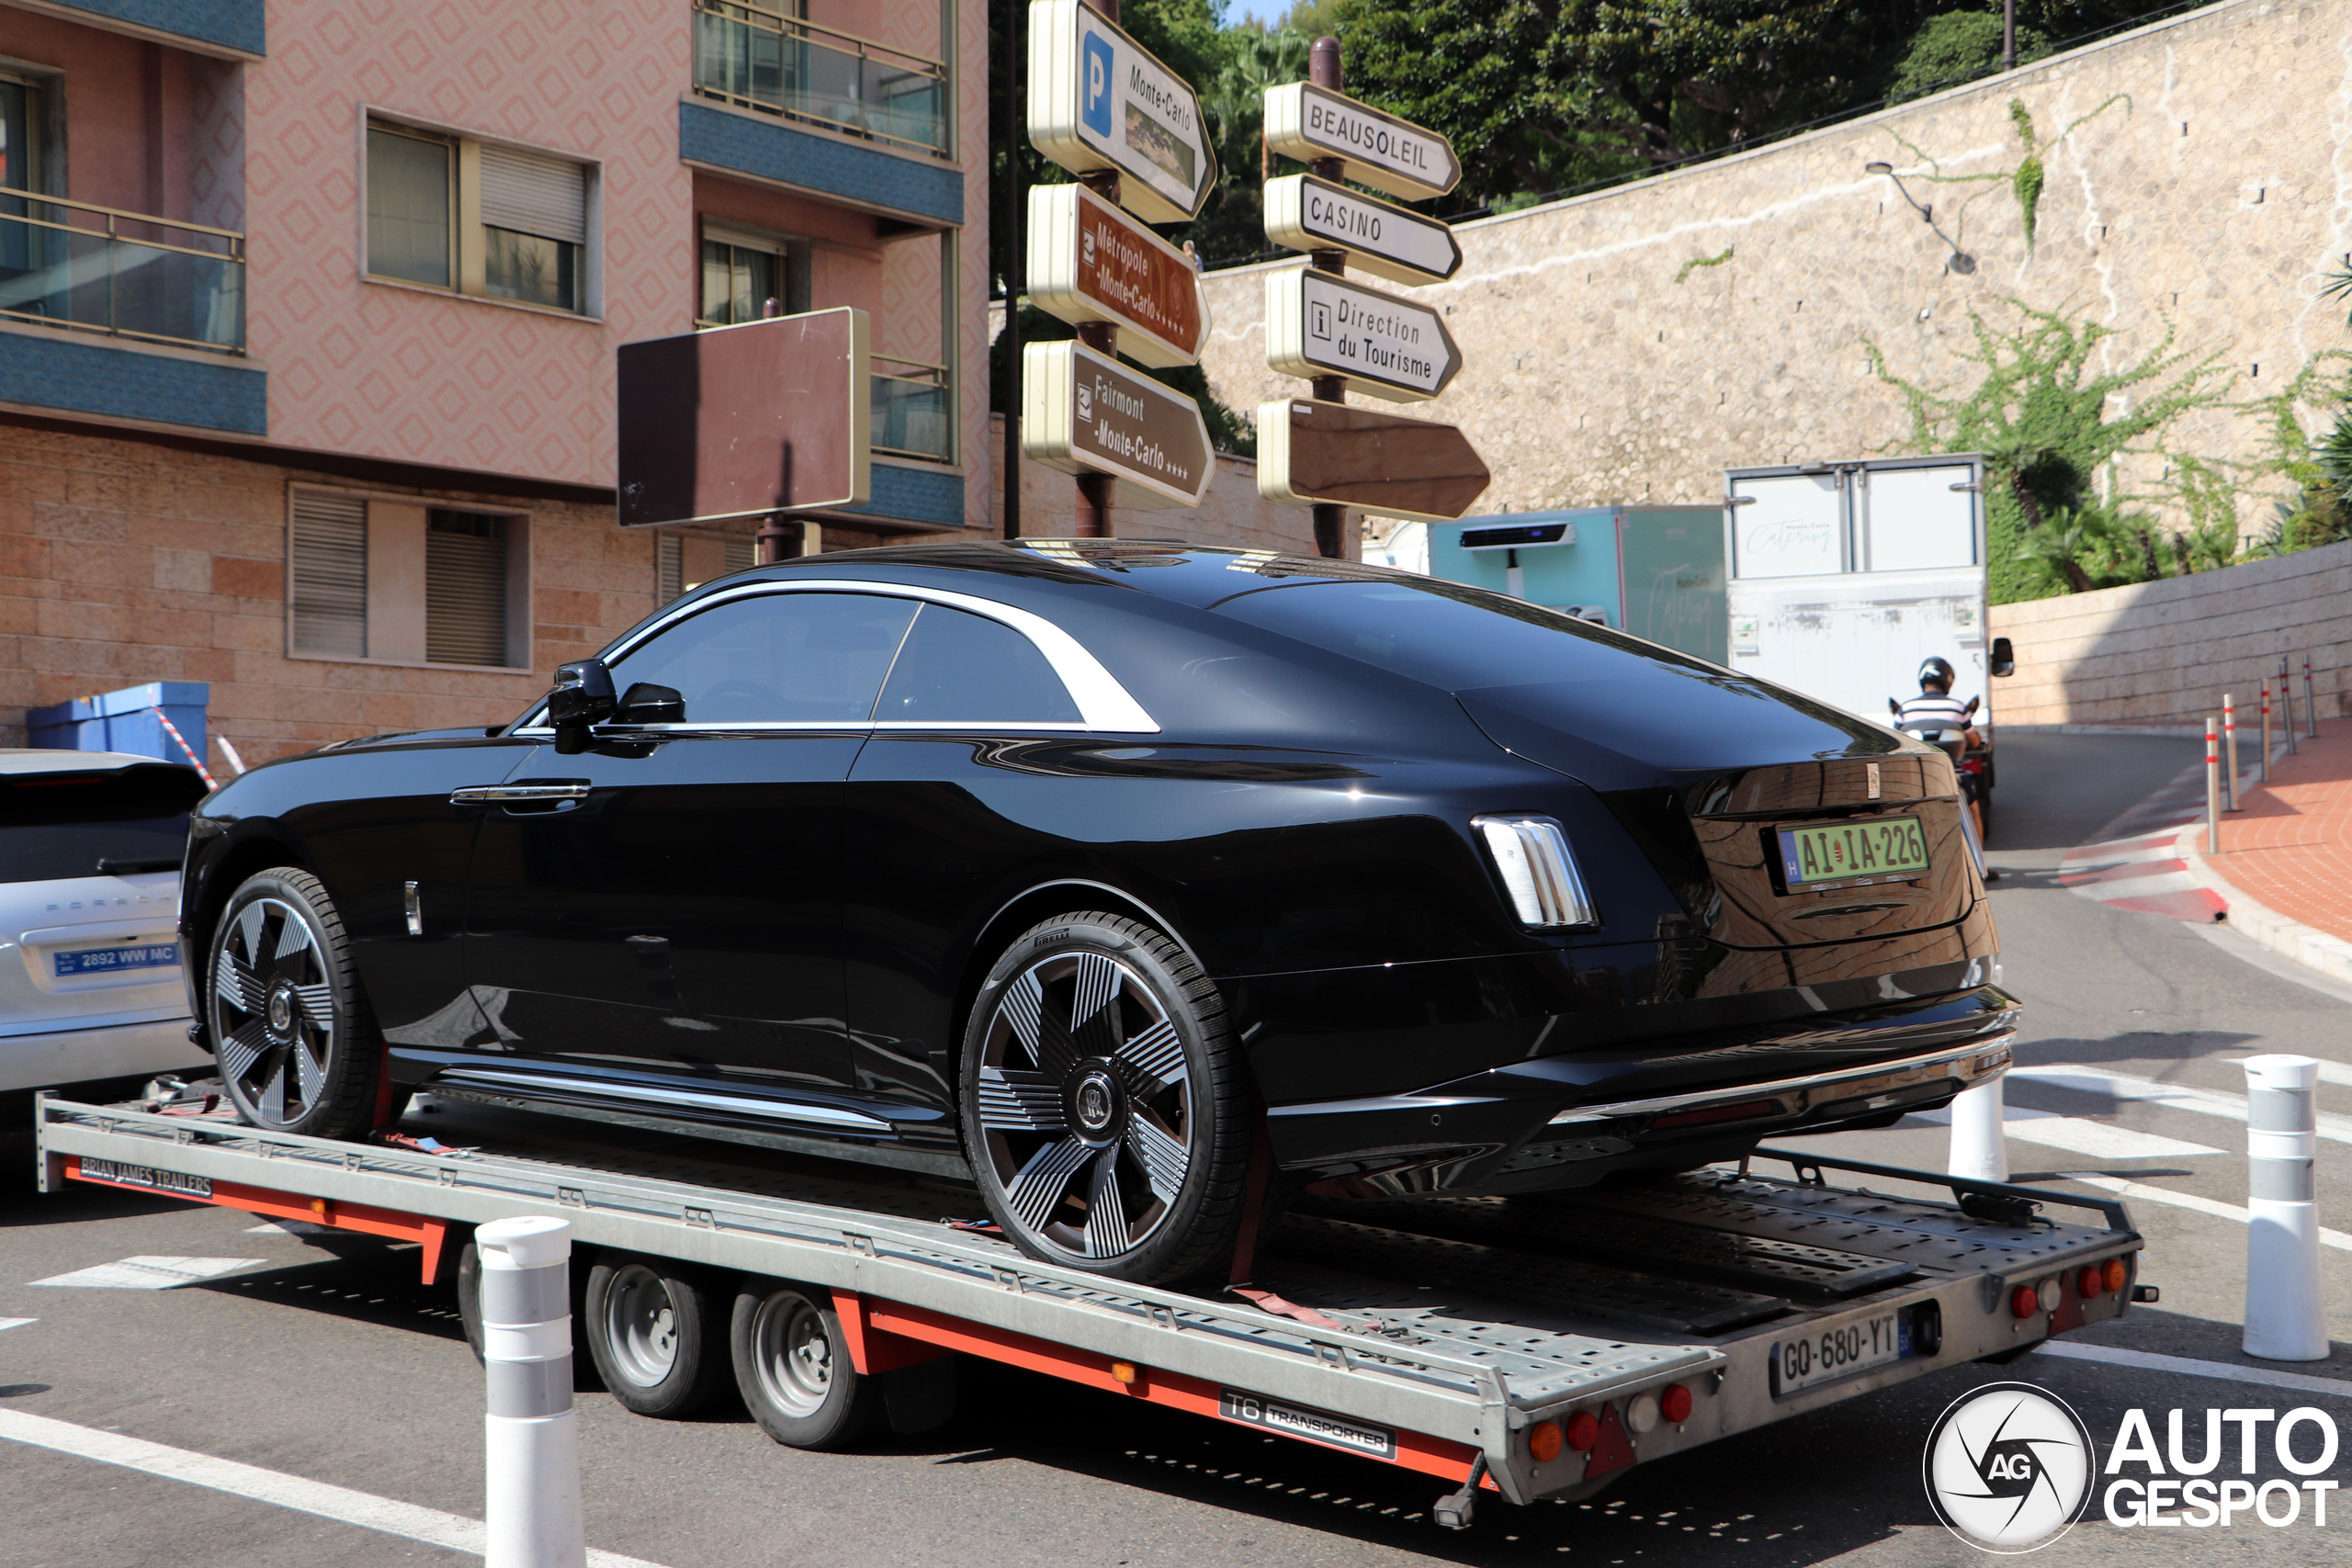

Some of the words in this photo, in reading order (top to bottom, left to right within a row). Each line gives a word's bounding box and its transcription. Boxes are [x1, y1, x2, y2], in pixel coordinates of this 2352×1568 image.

[1090, 51, 1104, 111] P
[1130, 64, 1191, 130] Monte-Carlo
[1310, 104, 1428, 170] BEAUSOLEIL
[1311, 196, 1381, 241] CASINO
[1097, 221, 1148, 276] Métropole
[1338, 299, 1419, 344] Direction
[1338, 333, 1356, 358] du
[1363, 338, 1431, 378] Tourisme
[1095, 374, 1144, 422] Fairmont
[1787, 862, 1798, 875] H
[83, 952, 116, 966] 2892
[119, 949, 147, 963] WW
[151, 947, 173, 960] MC
[1034, 928, 1069, 947] PIRELLI
[81, 1157, 115, 1176] BRIAN
[115, 1163, 153, 1186] JAMES
[155, 1169, 212, 1197] TRAILERS
[1785, 1315, 1894, 1380] GQ-680-YT
[1227, 1393, 1260, 1420] T6
[1269, 1408, 1385, 1448] TRANSPORTER
